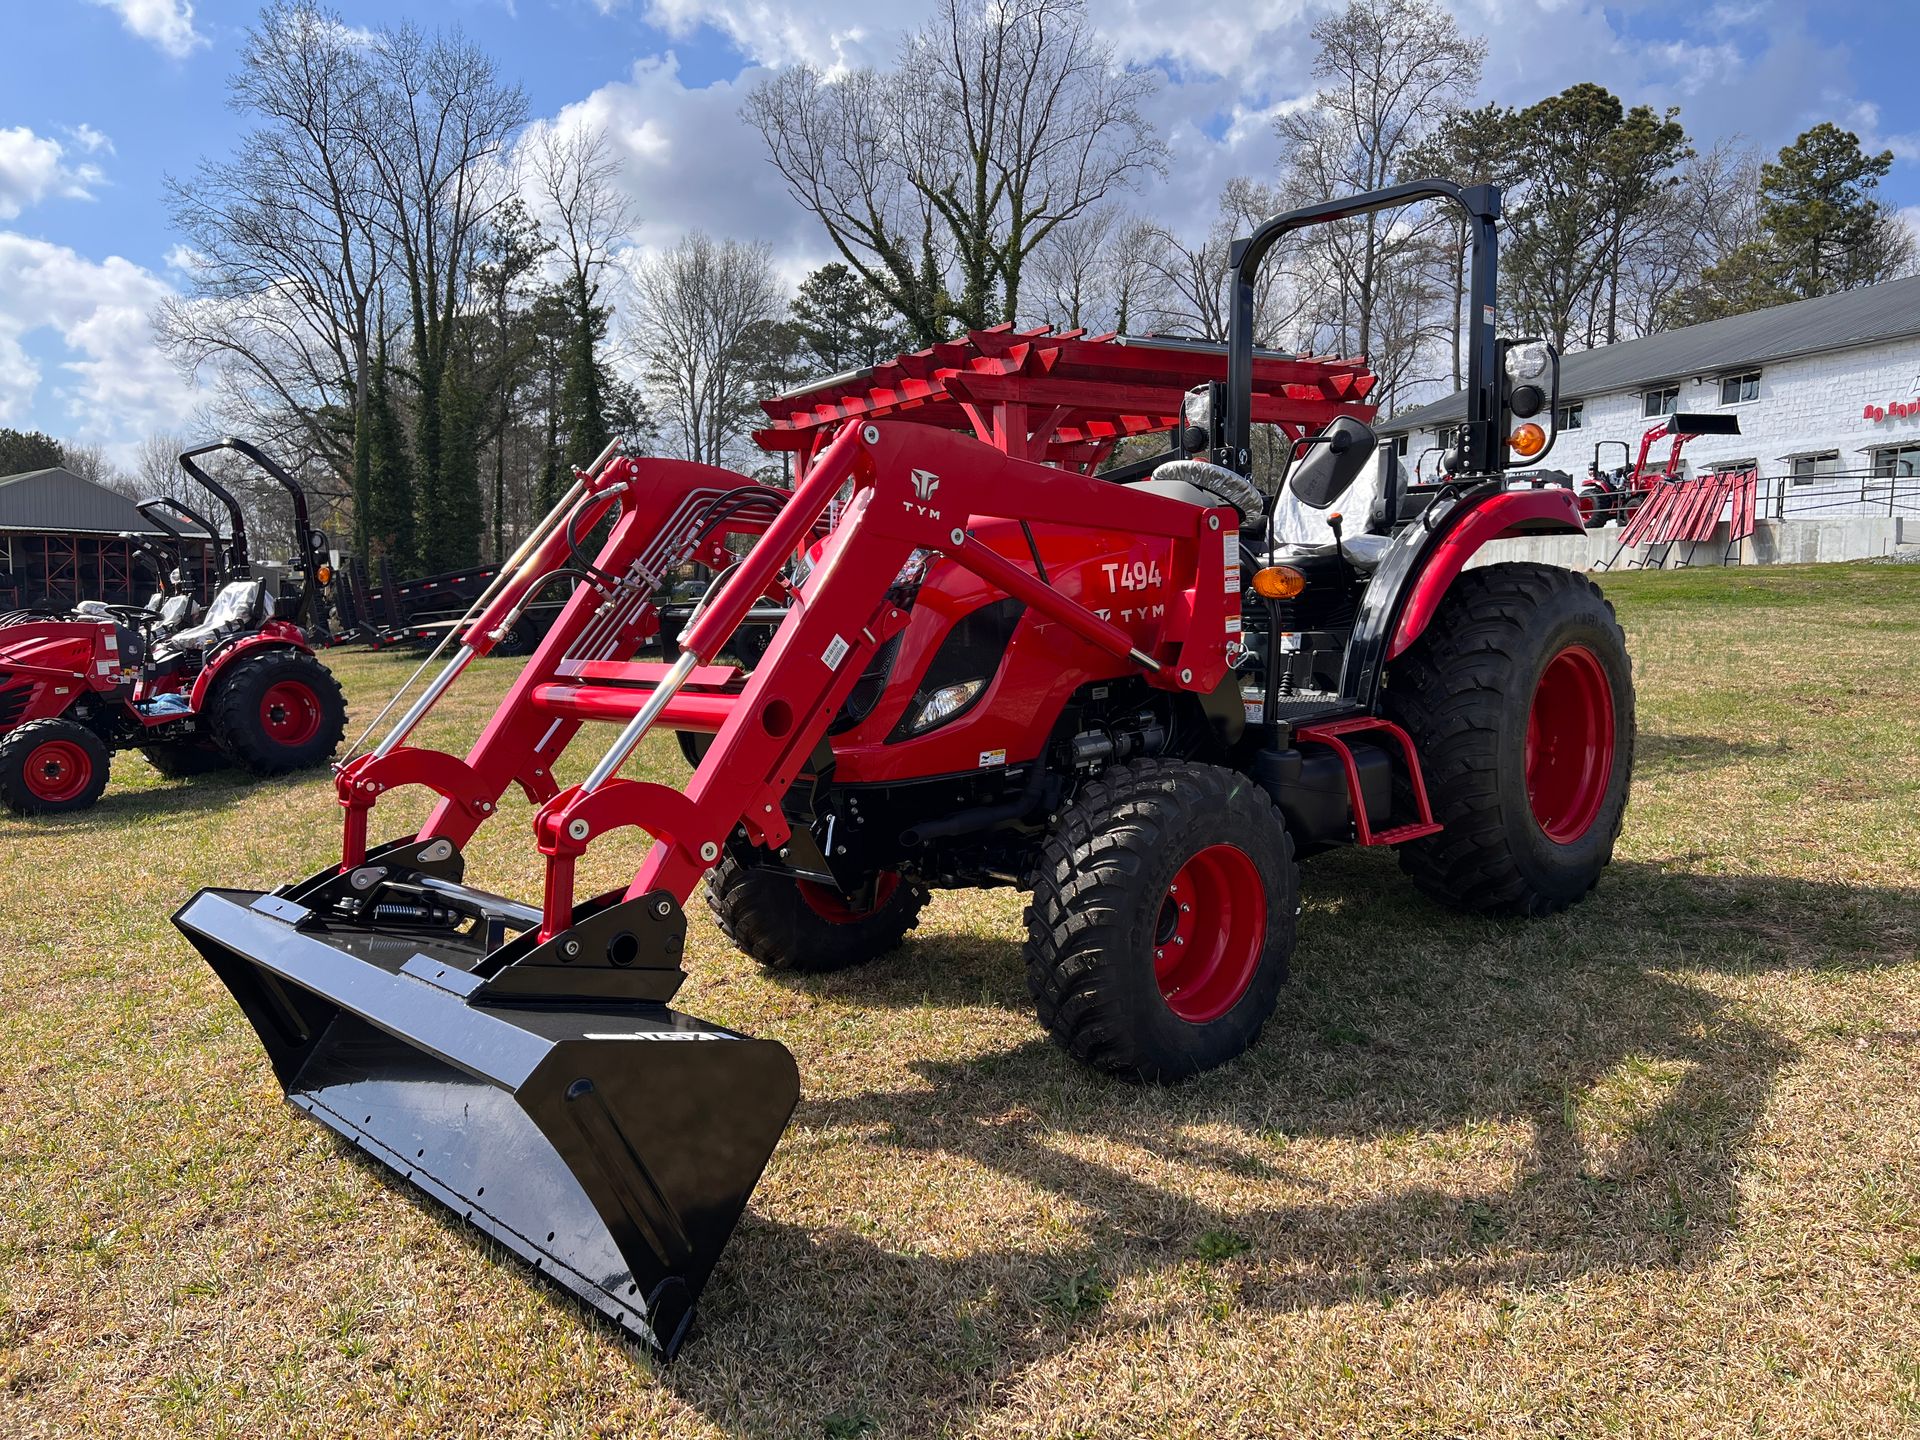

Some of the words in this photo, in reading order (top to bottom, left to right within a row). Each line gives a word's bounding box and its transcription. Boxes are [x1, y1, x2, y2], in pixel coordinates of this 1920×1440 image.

[903, 501, 940, 520] TYM
[1101, 561, 1162, 593] T494
[1120, 604, 1164, 623] TYM
